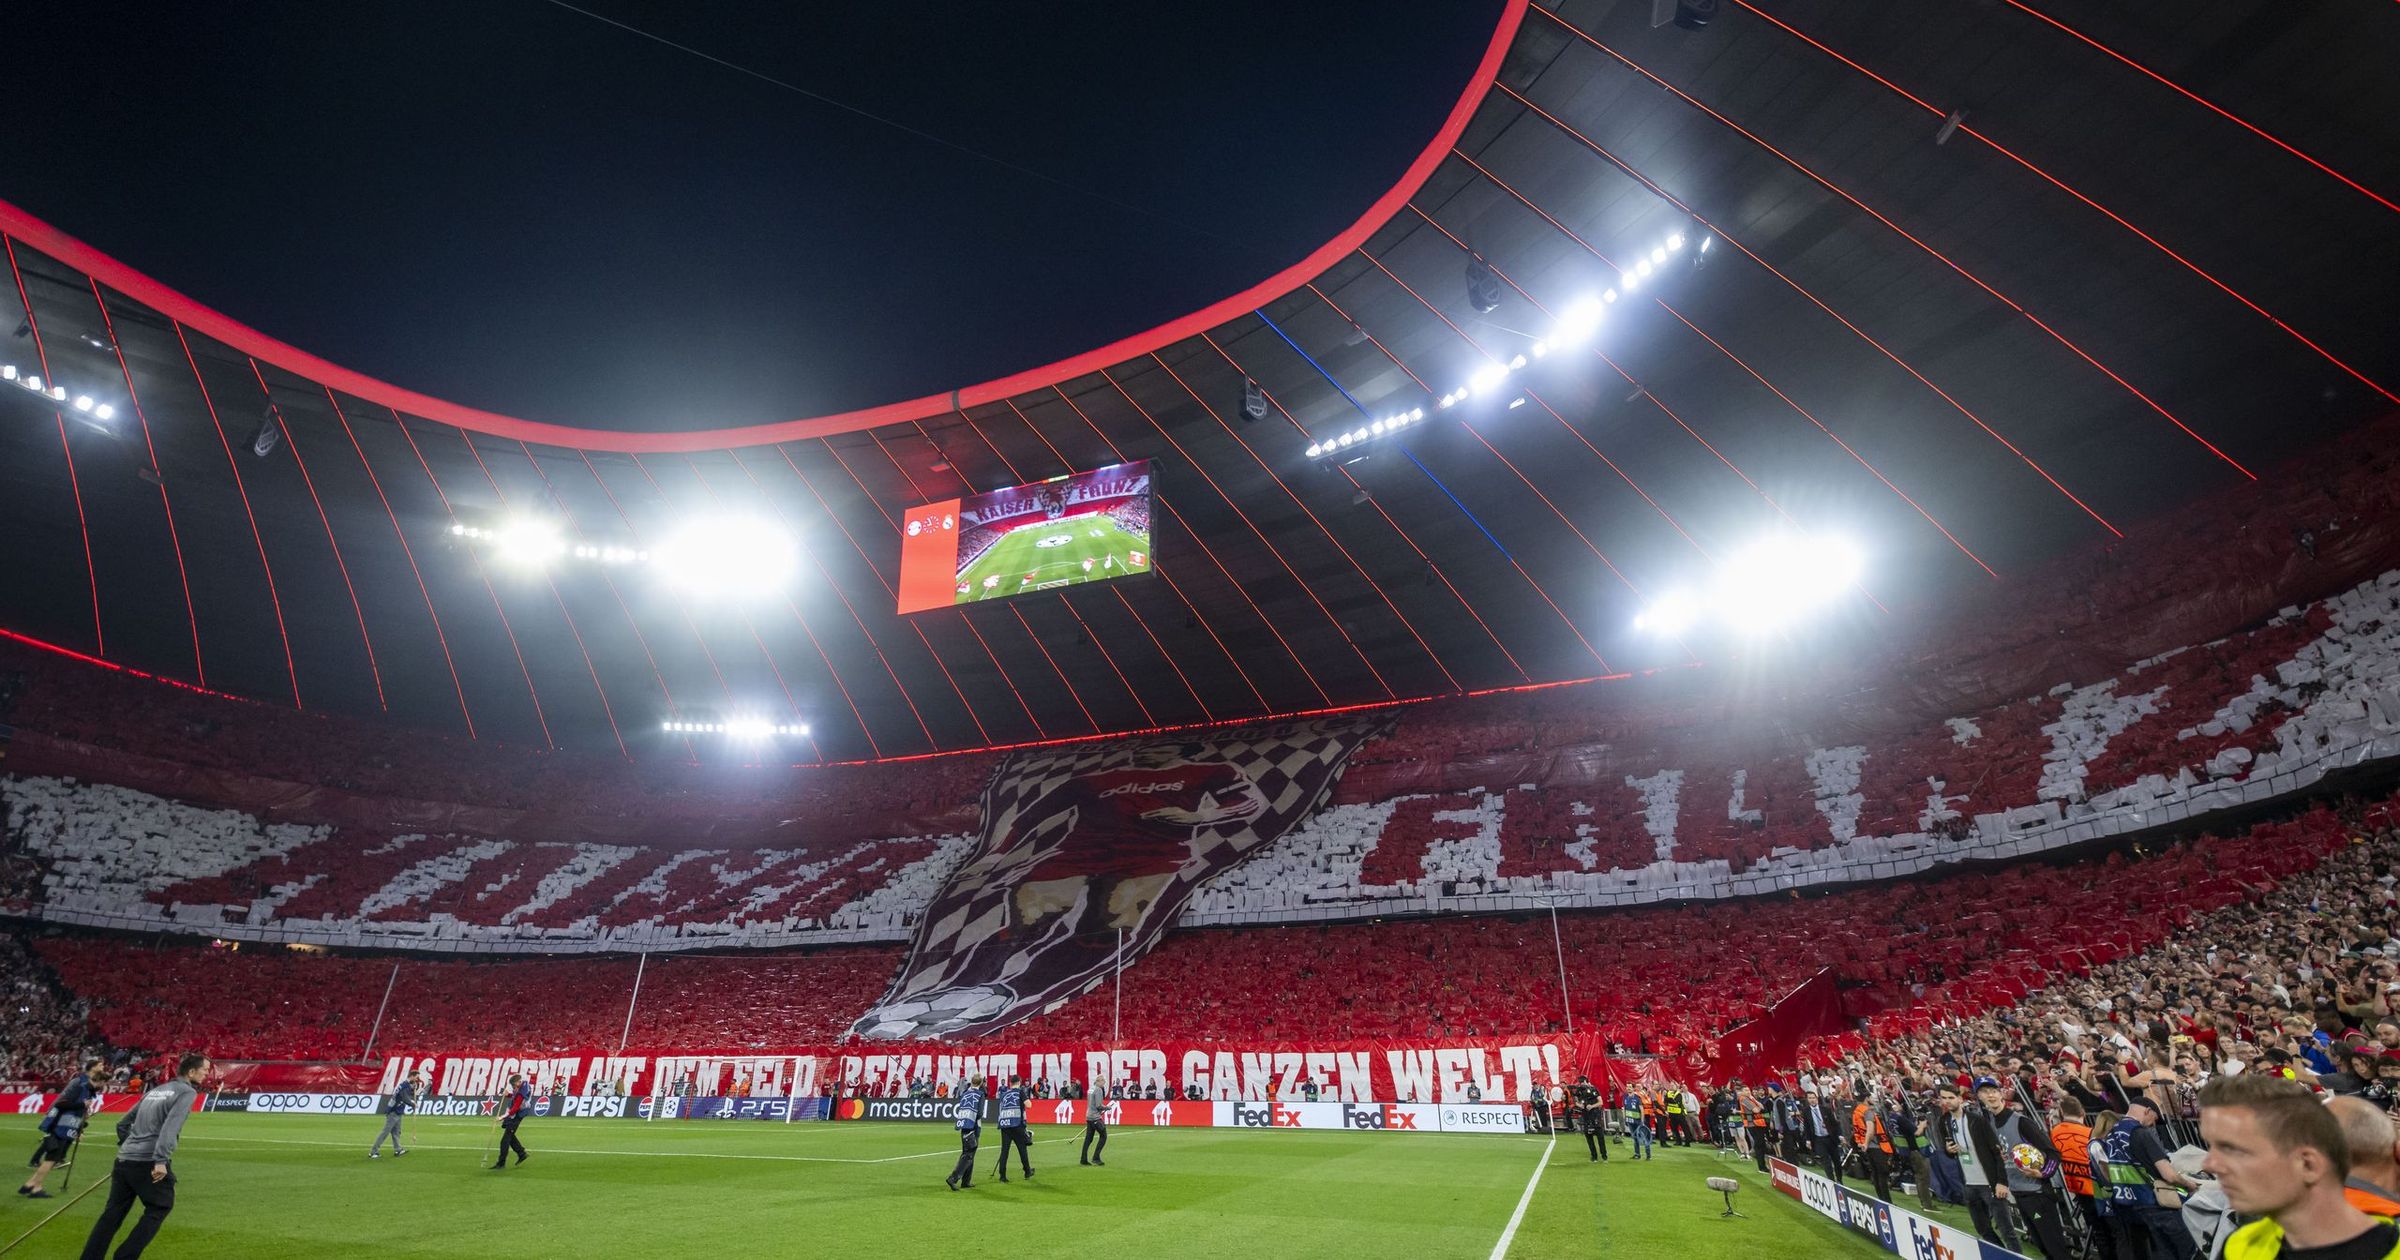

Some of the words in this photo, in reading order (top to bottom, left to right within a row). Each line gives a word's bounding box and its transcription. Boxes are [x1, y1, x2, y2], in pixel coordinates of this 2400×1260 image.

[976, 497, 1035, 523] KAISER
[1078, 476, 1142, 501] FRANZ
[1099, 782, 1184, 798] adidas
[1182, 1050, 1373, 1103] GANZEN
[1387, 1044, 1560, 1104] WELT!
[217, 1099, 248, 1107] RESPECT
[257, 1094, 310, 1111] oppo
[320, 1095, 372, 1113] oppo
[403, 1097, 478, 1116] eineken
[560, 1096, 628, 1118] PEPSI
[740, 1100, 787, 1116] PS5
[869, 1099, 988, 1118] masterc
[1233, 1103, 1301, 1127] FedEx
[1343, 1104, 1417, 1129] FedEx
[1462, 1112, 1520, 1125] RESPECT
[1846, 1196, 1879, 1236] PEPSI
